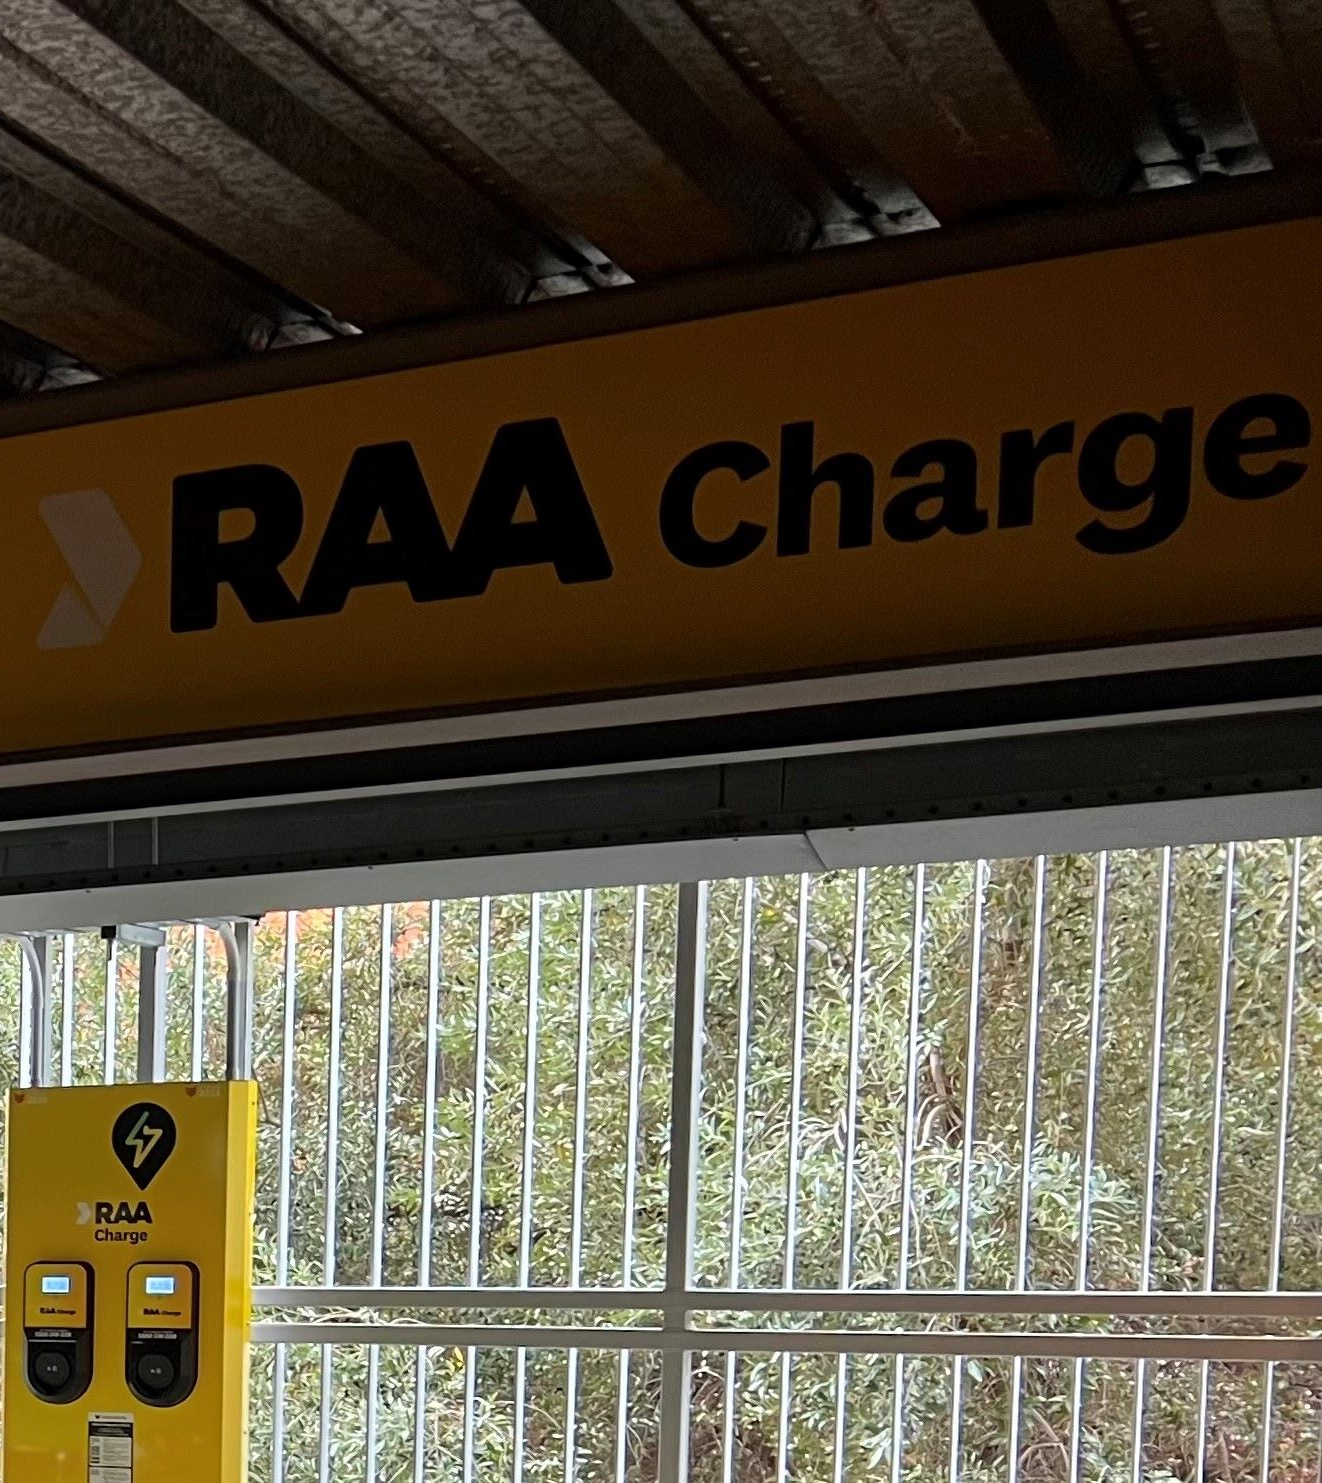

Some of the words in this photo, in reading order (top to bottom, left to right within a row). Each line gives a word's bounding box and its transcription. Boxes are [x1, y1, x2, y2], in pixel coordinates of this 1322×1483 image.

[169, 416, 613, 633] RAA
[658, 392, 1311, 568] Charge
[95, 1202, 153, 1224] RAA
[95, 1228, 148, 1245] Charge
